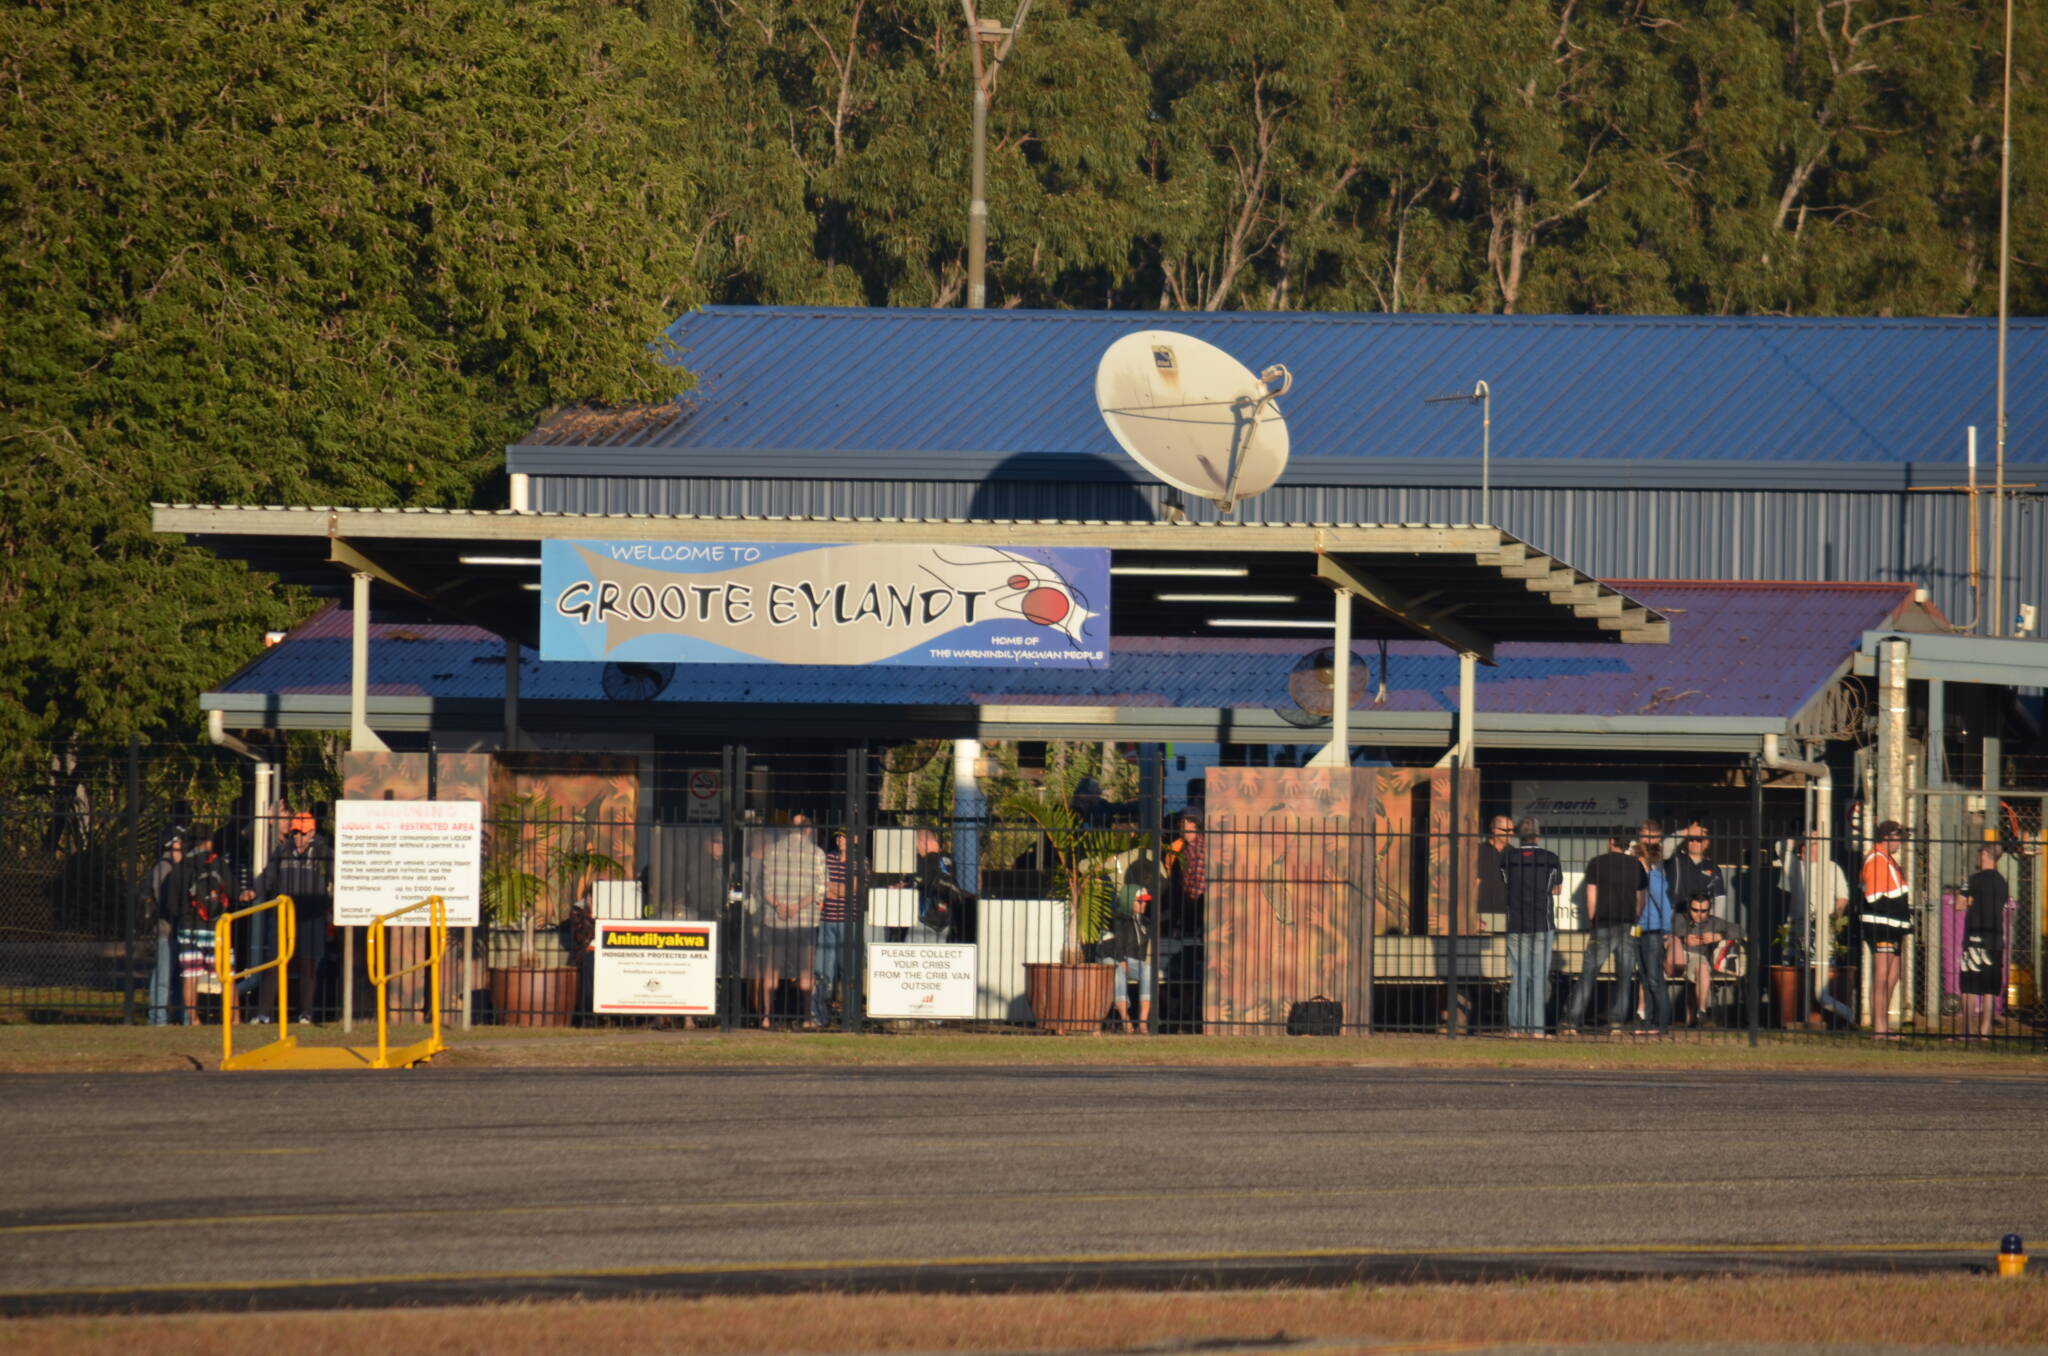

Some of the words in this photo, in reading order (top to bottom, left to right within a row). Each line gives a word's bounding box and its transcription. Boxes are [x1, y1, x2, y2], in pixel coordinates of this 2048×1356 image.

[611, 545, 725, 561] WELCOME
[731, 547, 761, 562] TO
[557, 580, 754, 625] GROOTE
[768, 580, 988, 629] EYLANDT
[991, 636, 1023, 646] HOME
[1024, 637, 1040, 646] OF
[929, 649, 951, 659] THE
[953, 650, 1062, 662] WARNINDILYAKWAN
[1063, 651, 1104, 660] PEOPLE
[400, 822, 449, 831] RESTRICTED
[452, 823, 475, 831] AREA
[607, 932, 705, 948] Anindilyakwa
[602, 951, 645, 959] INDIGENOUS
[881, 949, 916, 958] PLEASE
[920, 950, 963, 959] COLLECT
[894, 960, 919, 969] YOUR
[922, 960, 951, 970] CRIBS
[873, 970, 900, 979] FROM
[904, 971, 922, 980] THE
[925, 972, 948, 981] CRIB
[951, 972, 971, 981] VAN
[901, 982, 942, 991] OUTSIDE
